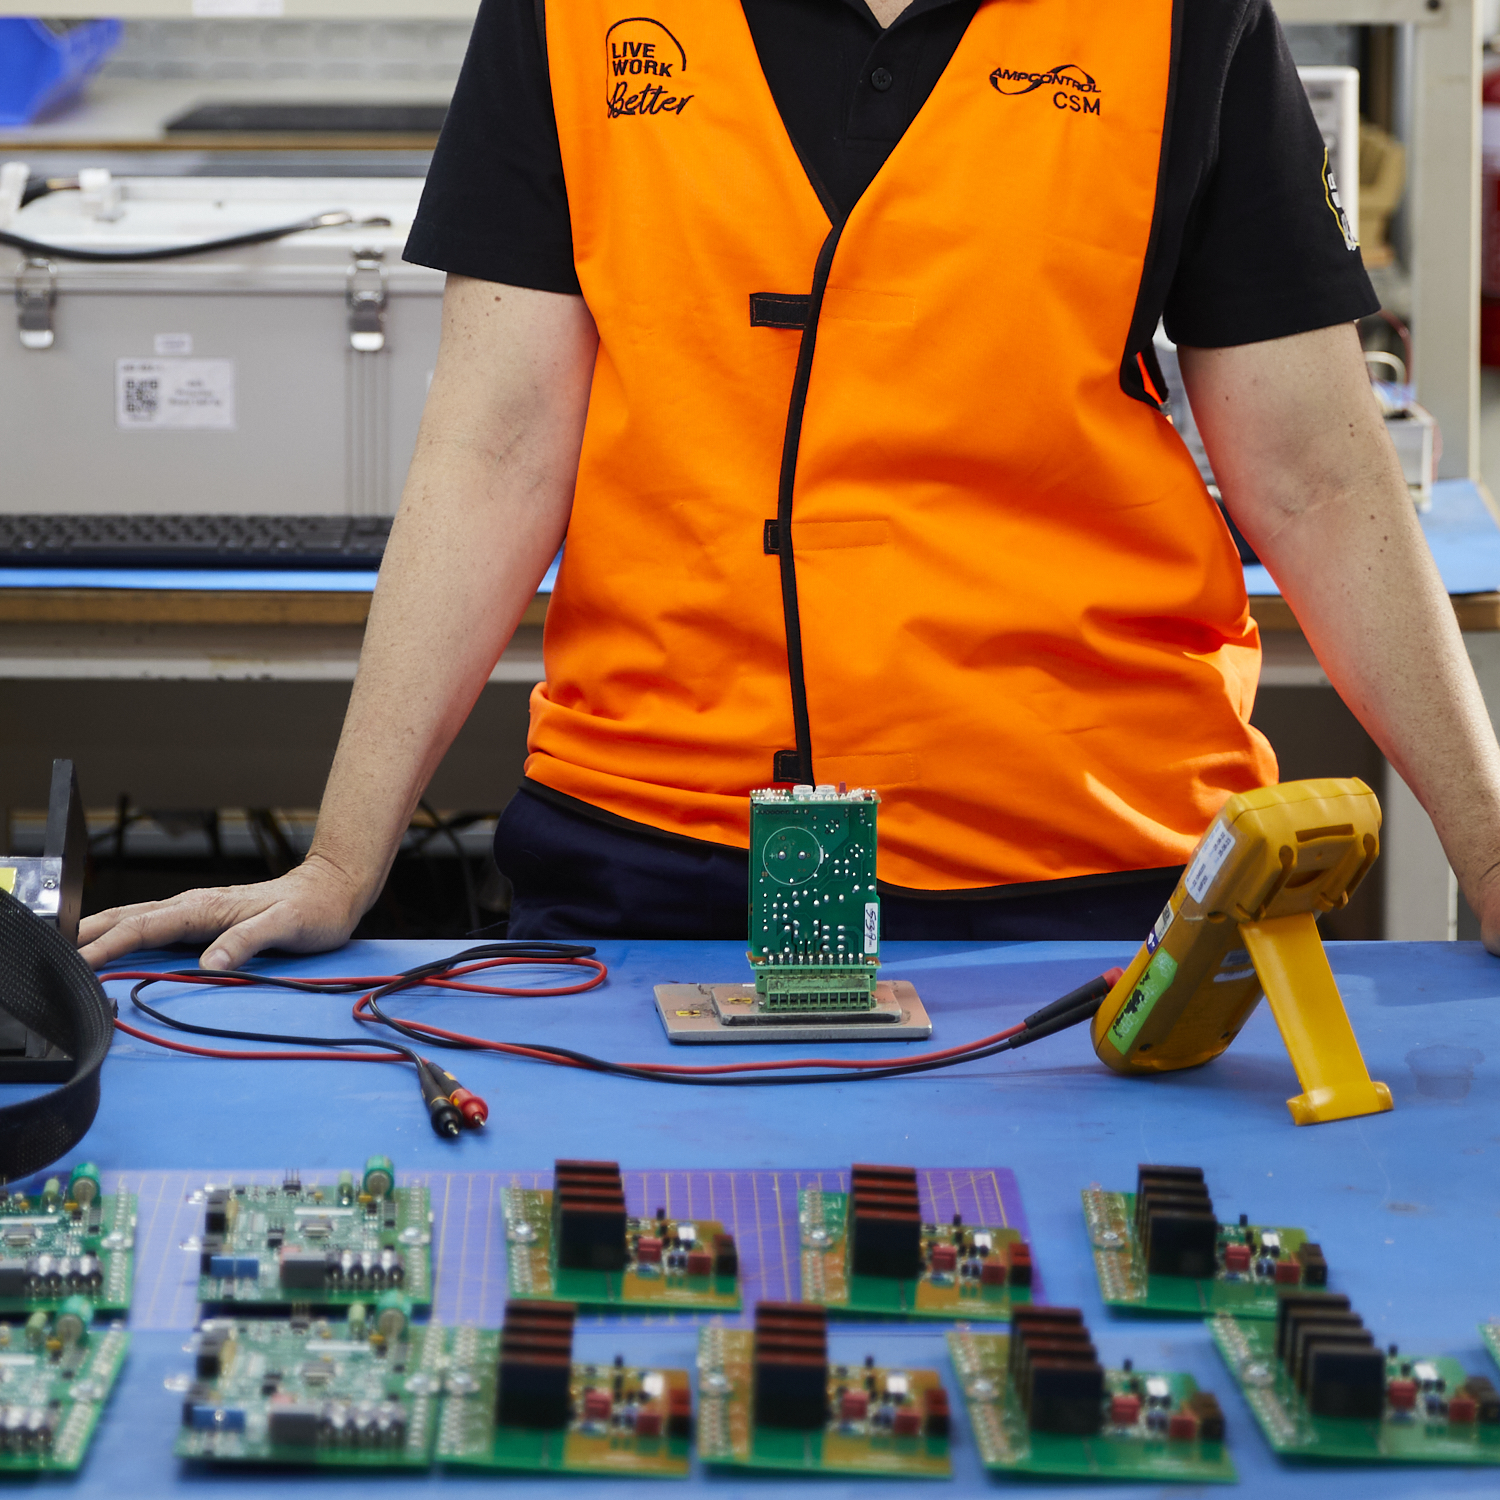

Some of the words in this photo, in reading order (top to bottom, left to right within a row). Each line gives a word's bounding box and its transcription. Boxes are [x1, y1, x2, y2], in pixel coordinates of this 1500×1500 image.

[612, 41, 656, 59] LIVE
[612, 60, 673, 78] WORK
[992, 67, 1102, 93] AMPCONTROL
[607, 81, 695, 119] Better
[1052, 92, 1101, 116] CSM
